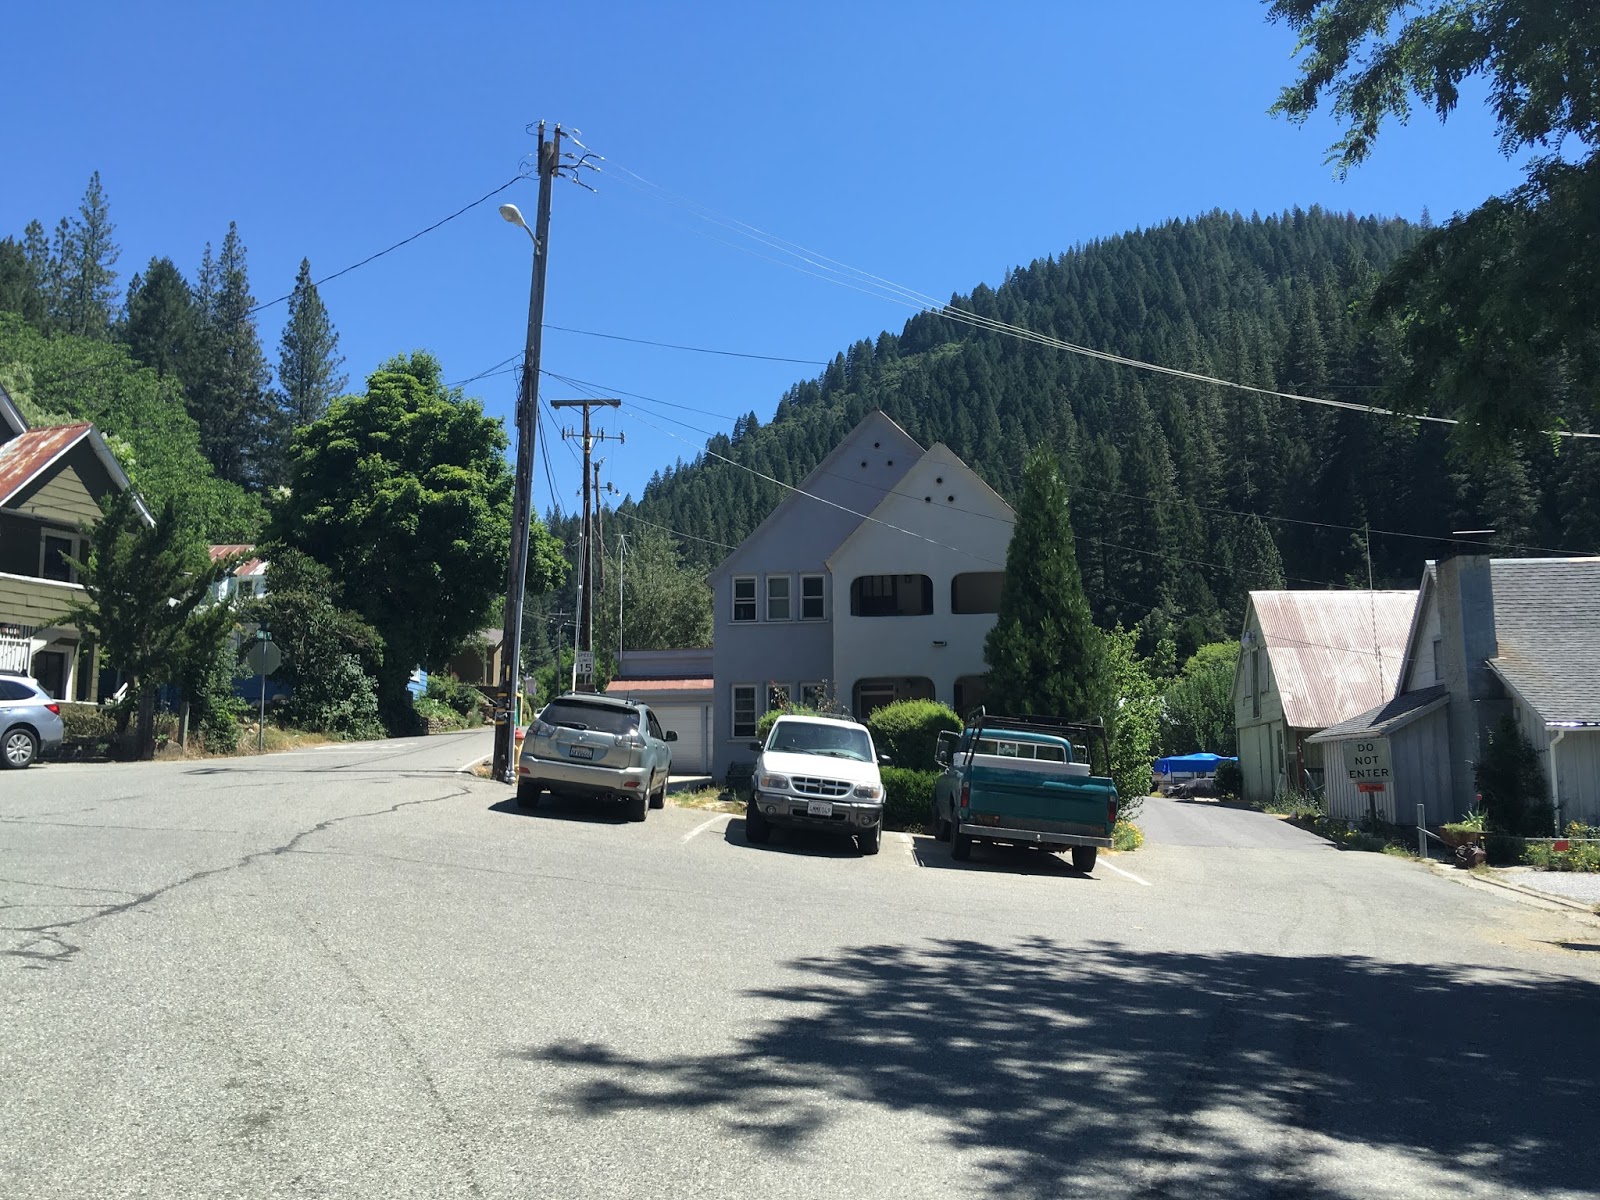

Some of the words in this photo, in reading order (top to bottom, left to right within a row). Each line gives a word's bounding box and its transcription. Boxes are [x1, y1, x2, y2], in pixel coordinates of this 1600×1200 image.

[580, 663, 592, 672] 15
[1357, 743, 1374, 752] DO
[1354, 755, 1379, 765] NOT
[1349, 768, 1389, 779] ENTER
